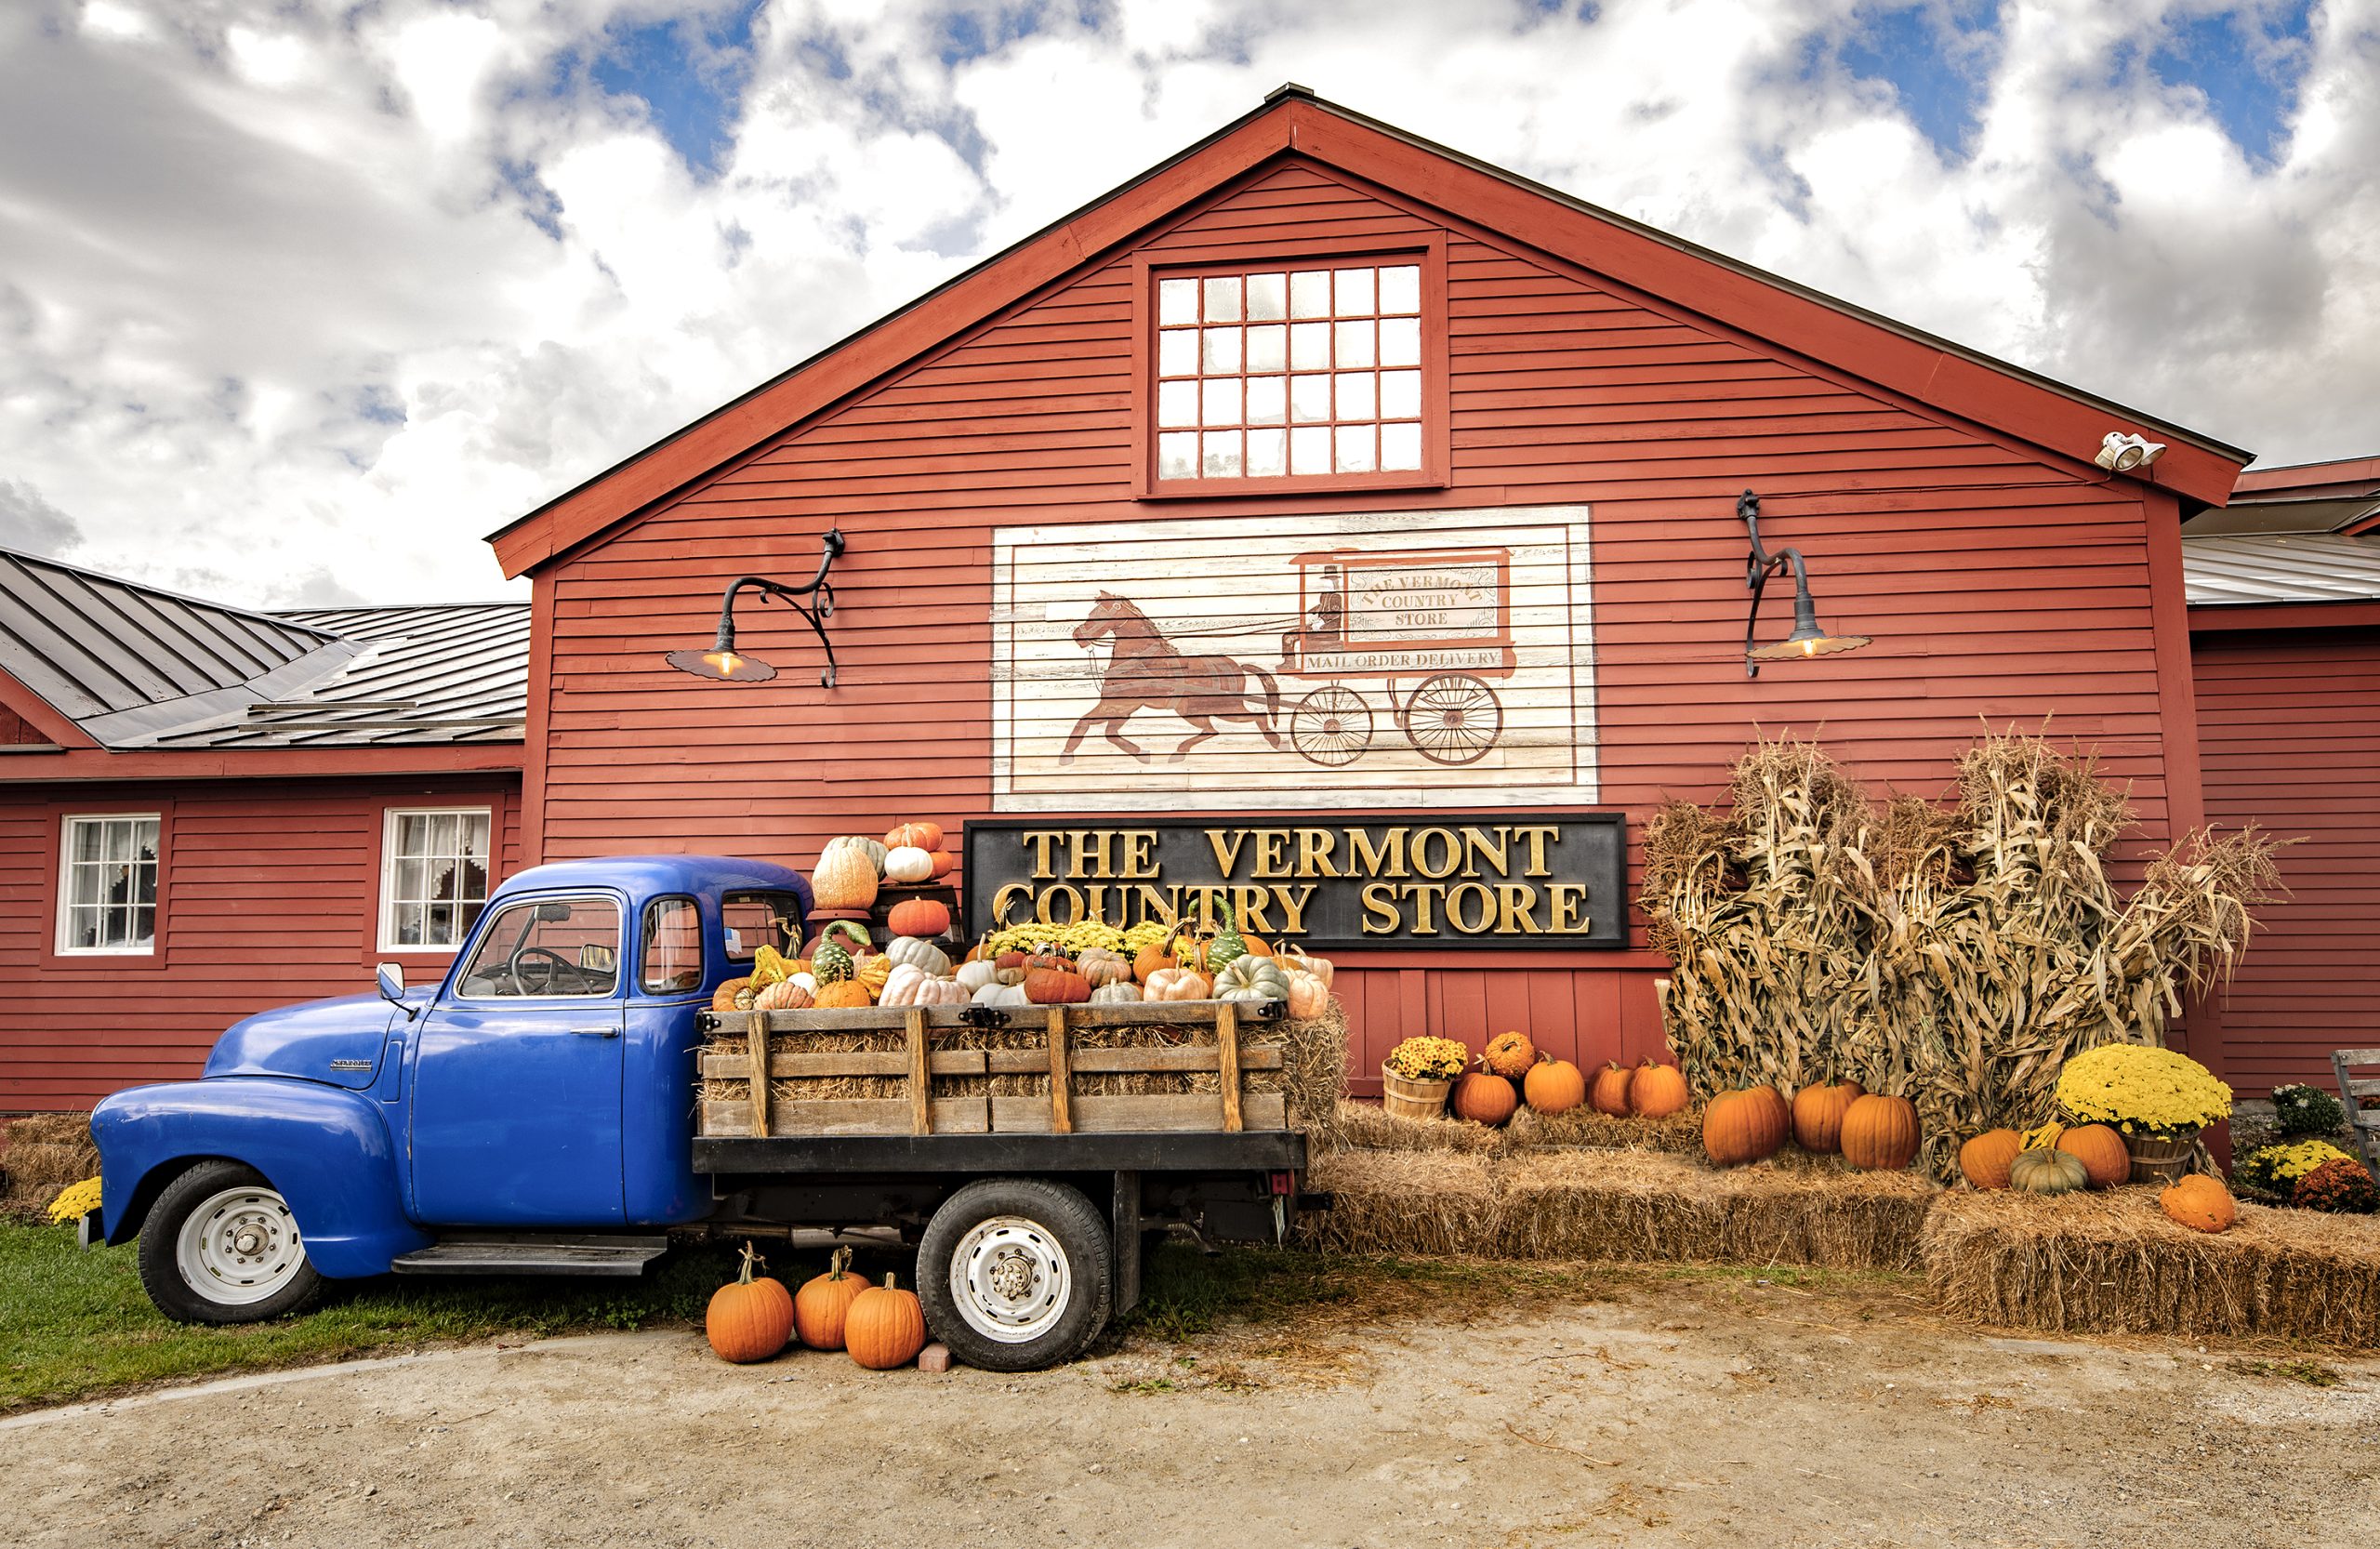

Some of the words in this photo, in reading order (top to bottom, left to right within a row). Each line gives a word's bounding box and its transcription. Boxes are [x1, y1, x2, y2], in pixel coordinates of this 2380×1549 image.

[1361, 578, 1395, 605] THE
[1398, 576, 1483, 602] VERMONT
[1382, 594, 1459, 609] COUNTRY
[1395, 613, 1448, 626] STORE
[1307, 655, 1352, 669] MAIL
[1355, 654, 1410, 667] ORDER
[1023, 830, 1160, 879] THE
[1204, 826, 1560, 879] VERMONT
[992, 882, 1318, 933] COUNTRY
[1361, 882, 1591, 934] STORE
